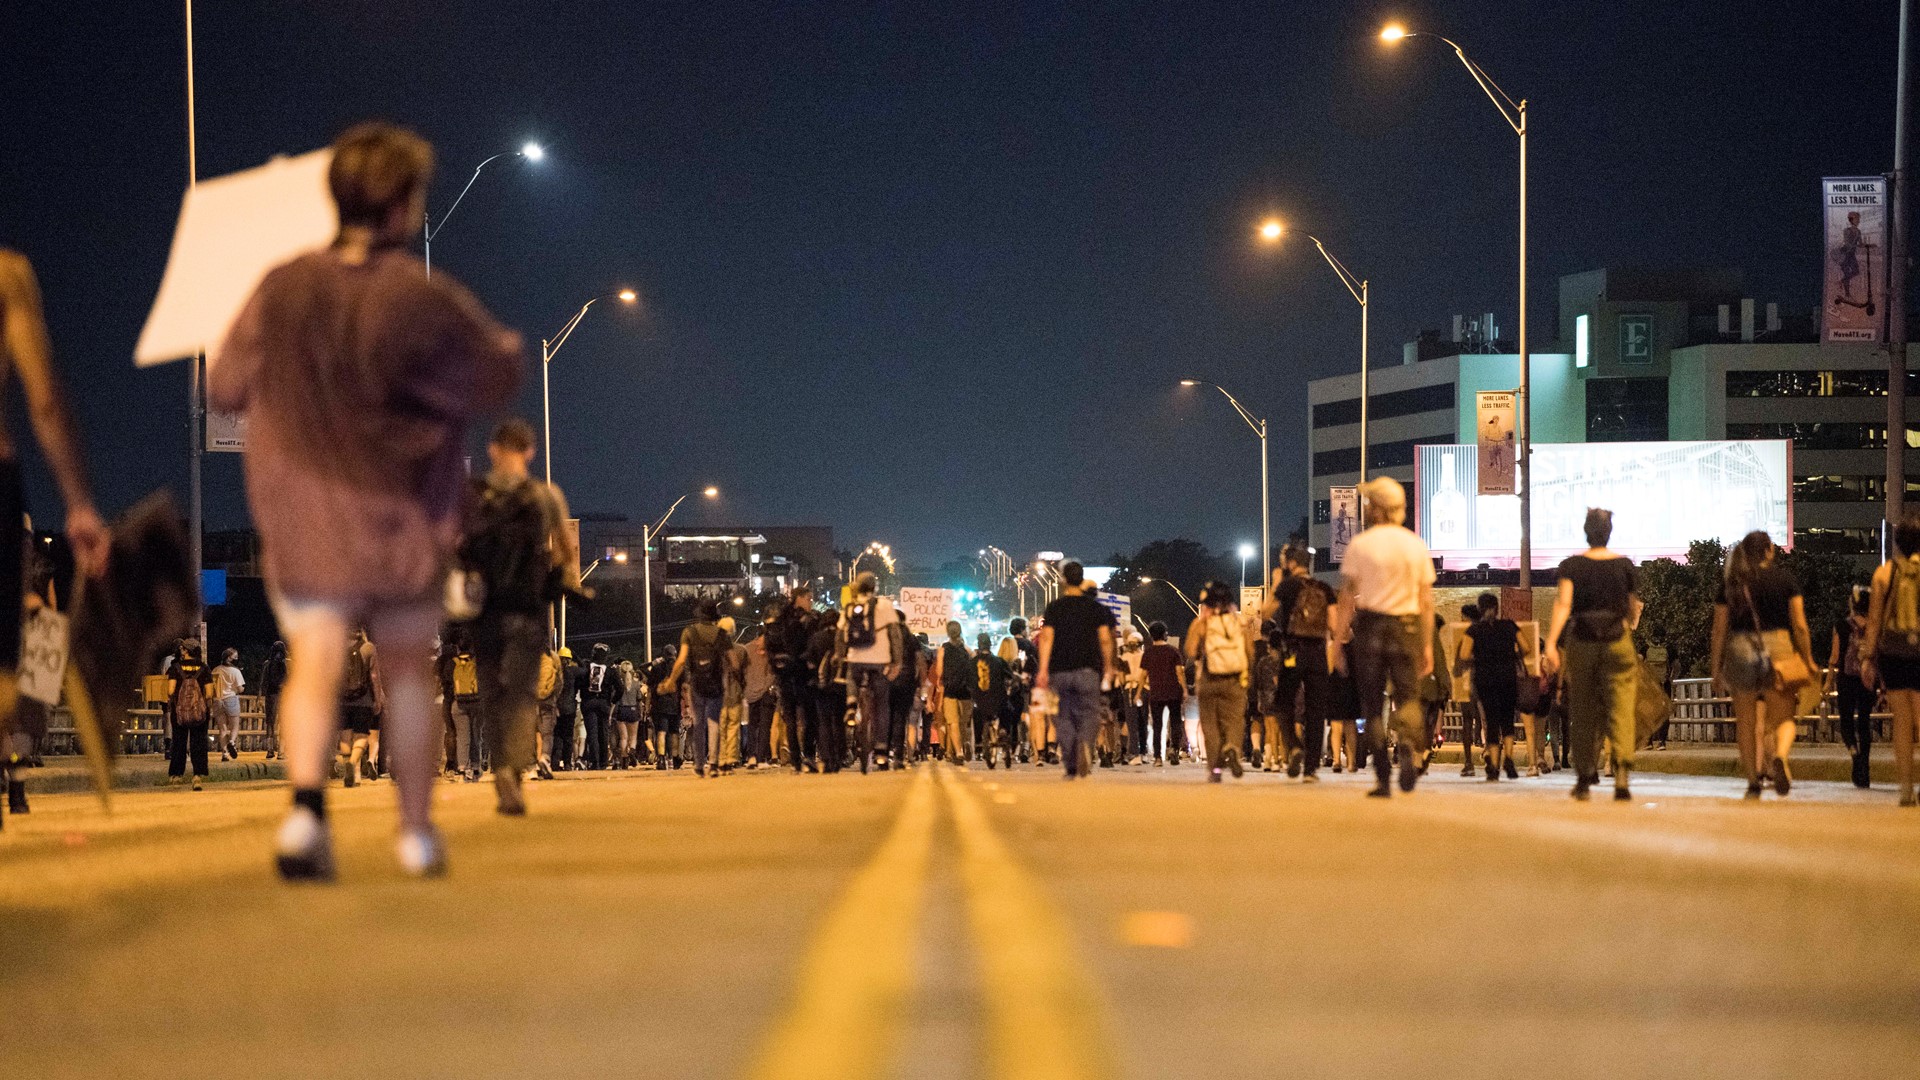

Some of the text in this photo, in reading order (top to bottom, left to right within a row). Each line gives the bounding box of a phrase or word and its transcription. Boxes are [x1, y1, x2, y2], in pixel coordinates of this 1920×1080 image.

[1833, 184, 1876, 192] MORE LANES.
[1831, 196, 1878, 204] LESS TRAFFIC.
[1833, 331, 1871, 340] MoveATX.org
[914, 603, 949, 615] POLICE
[908, 616, 948, 628] #BLM
